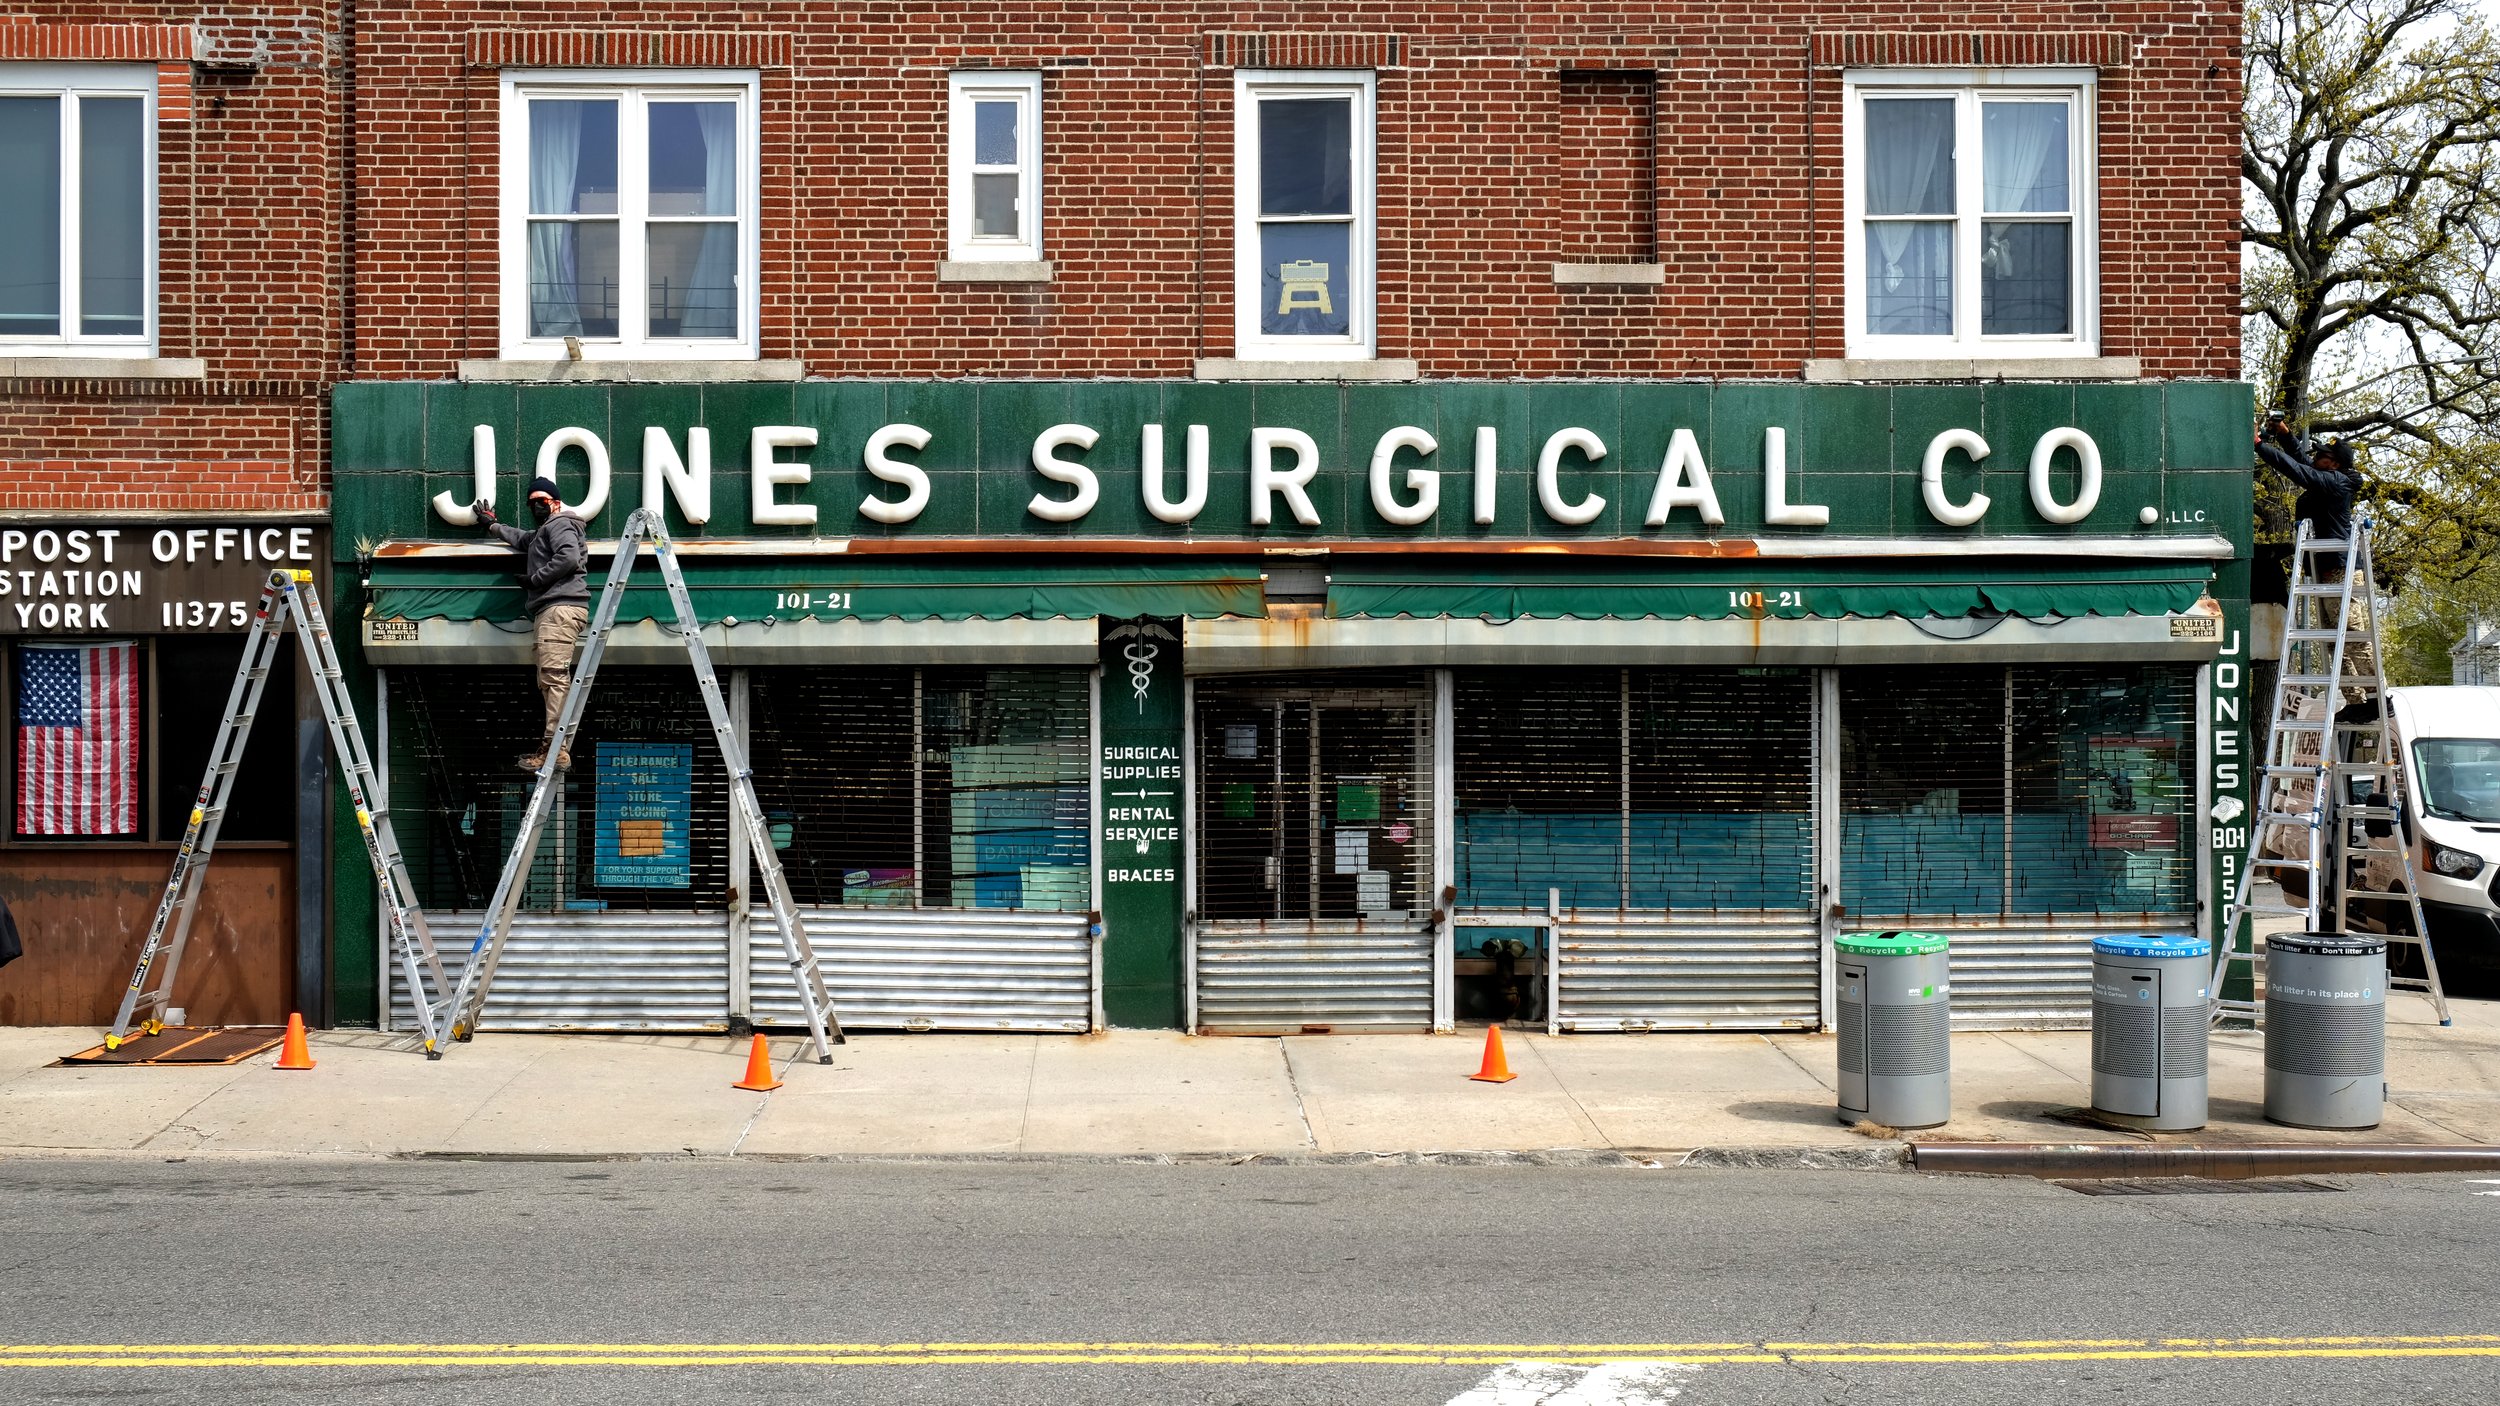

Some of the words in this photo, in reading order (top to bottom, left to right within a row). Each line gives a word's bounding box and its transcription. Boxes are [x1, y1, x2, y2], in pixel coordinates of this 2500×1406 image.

[432, 424, 932, 526] JONES
[1027, 423, 1829, 526] SURGICAL
[1922, 426, 2159, 526] CO.
[2, 529, 121, 563] POST
[151, 527, 313, 563] OFFICE
[0, 569, 142, 597] STATION
[776, 592, 851, 609] 101-21
[1728, 591, 1802, 608] 101-21
[15, 602, 110, 629] YORK
[162, 600, 248, 628] 11375
[375, 622, 415, 630] UNITED
[2216, 630, 2240, 789] JONES
[1104, 747, 1180, 760] SURGICAL
[611, 756, 678, 768] CLEARANCE
[631, 772, 658, 784] SALE
[1103, 766, 1181, 779] SUPPLIES
[628, 790, 662, 802] STORE
[620, 806, 667, 818] CLOSING
[989, 800, 1077, 818] CUSHIONS
[1109, 807, 1175, 820] RENTAL
[1105, 827, 1179, 840] SERVICE
[984, 844, 1083, 860] BATHROOM
[603, 865, 619, 874] FOR
[620, 865, 644, 874] YOUR
[645, 866, 683, 874] SUPPORT
[1108, 869, 1175, 882] BRACES
[601, 874, 640, 882] THROUGH
[641, 875, 658, 883] THE
[658, 875, 685, 883] YEARS
[1859, 947, 1897, 955] Recycle
[1918, 943, 1945, 953] Recycle
[2097, 946, 2126, 955] Recycle
[2147, 949, 2186, 957] Recycle
[2270, 941, 2283, 950] Don't
[2284, 944, 2301, 953] litter
[2322, 947, 2343, 955] Don't
[2272, 983, 2283, 993] Put
[2284, 985, 2305, 996] litter
[2307, 988, 2316, 997] in
[2319, 989, 2331, 998] its
[2334, 989, 2360, 999] place
